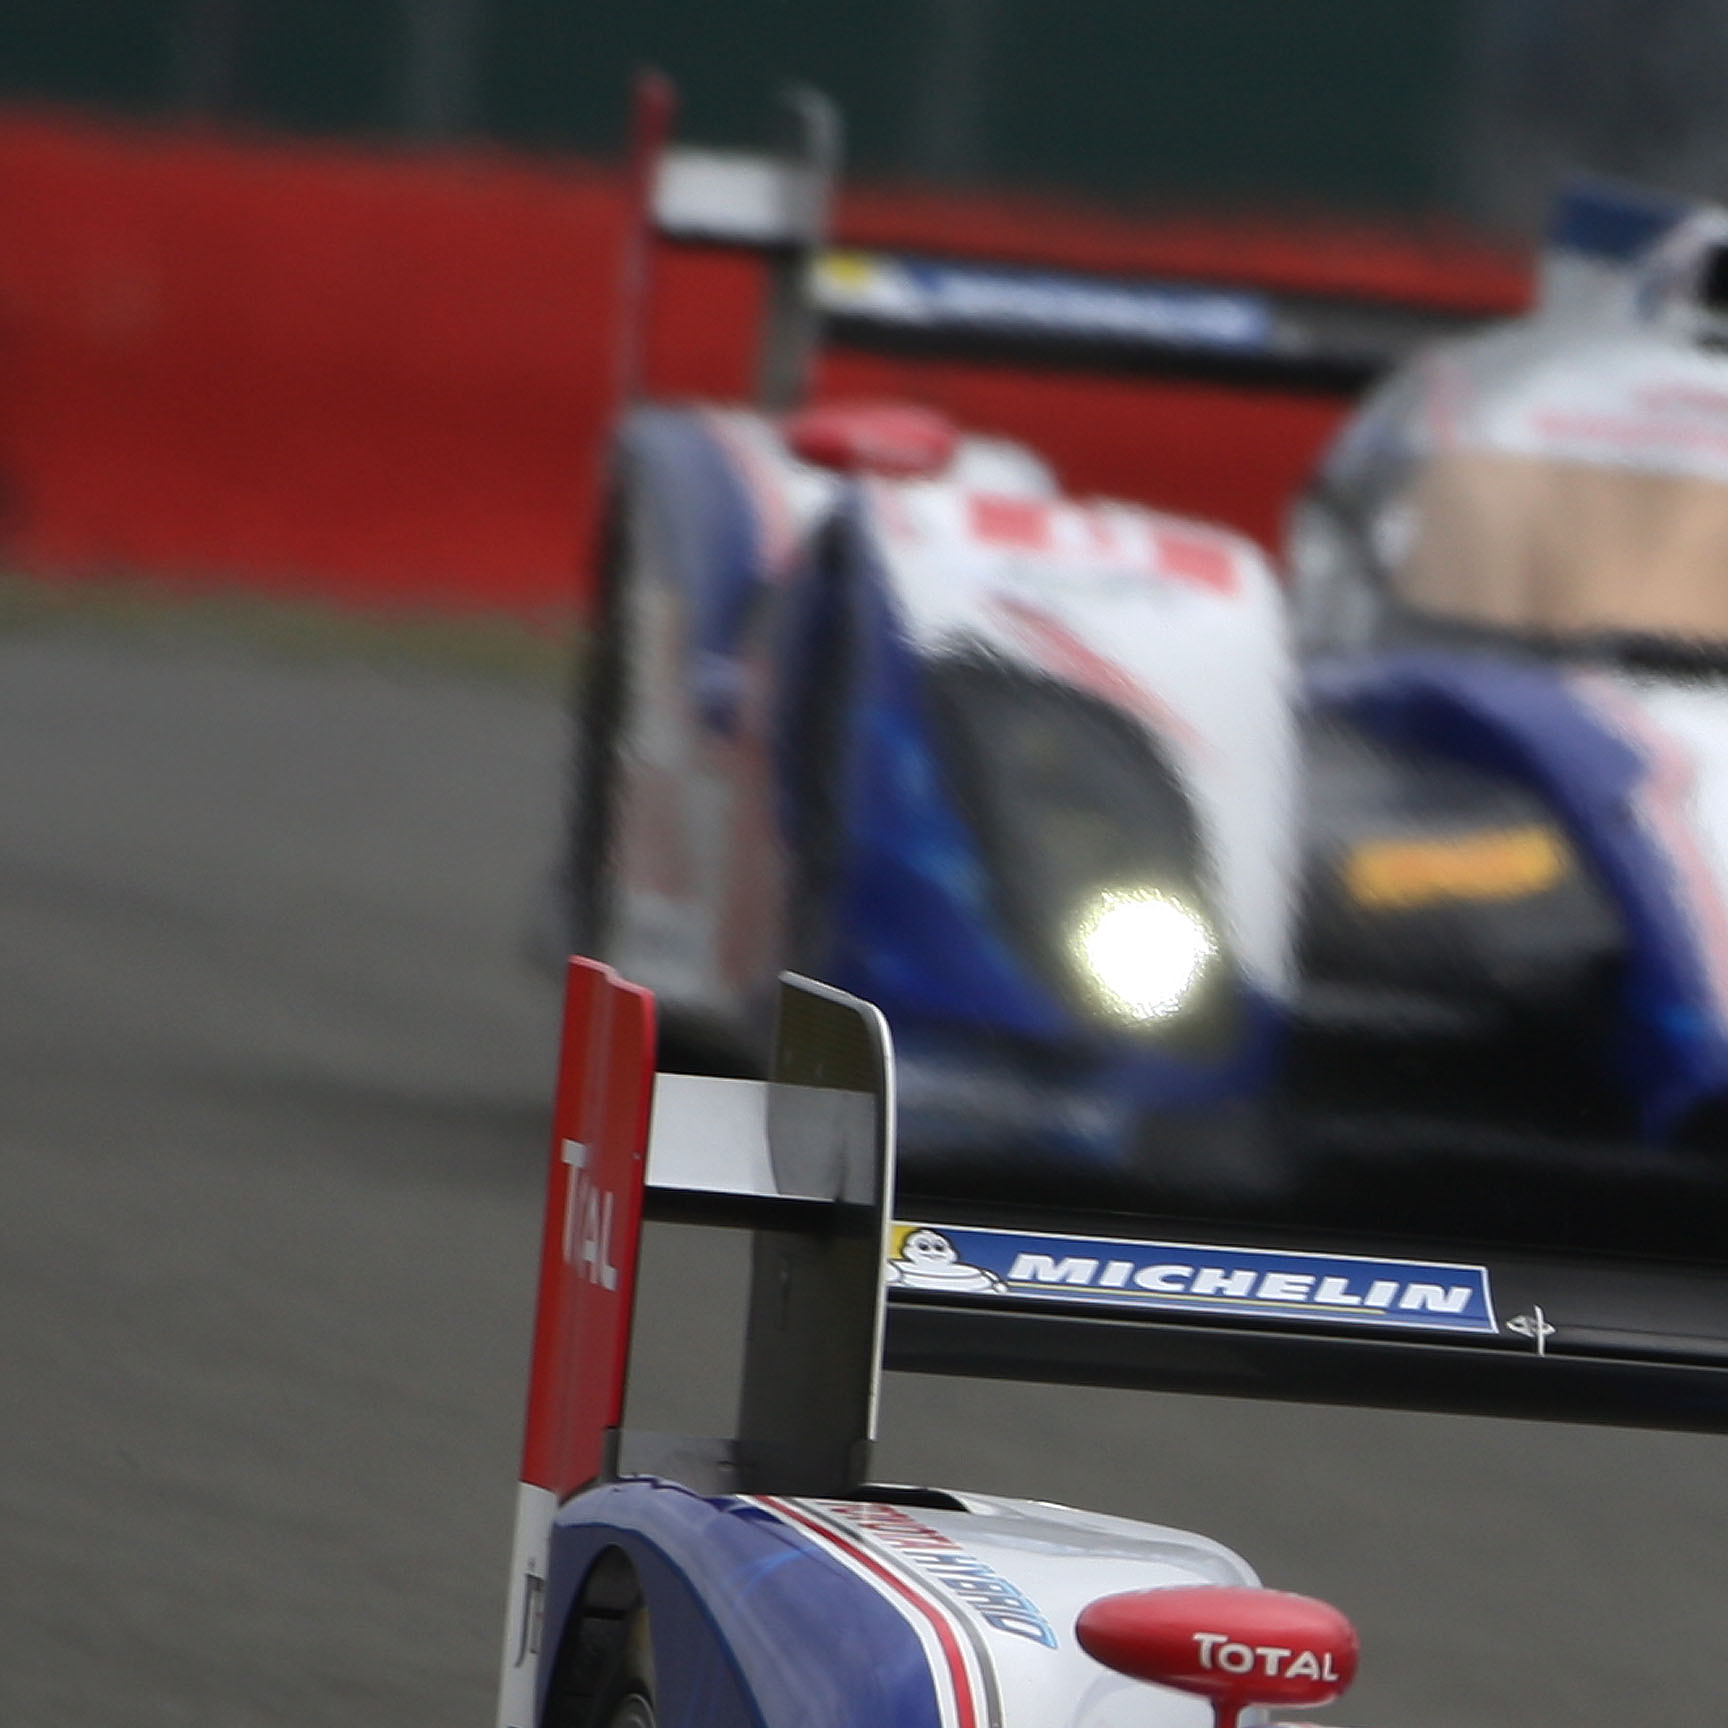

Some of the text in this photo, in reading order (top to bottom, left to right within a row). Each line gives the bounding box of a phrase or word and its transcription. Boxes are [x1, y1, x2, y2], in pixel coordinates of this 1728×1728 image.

[560, 1138, 618, 1291] TAL
[1006, 1253, 1472, 1313] MICHELIN
[1193, 1632, 1339, 1683] TOTAL
